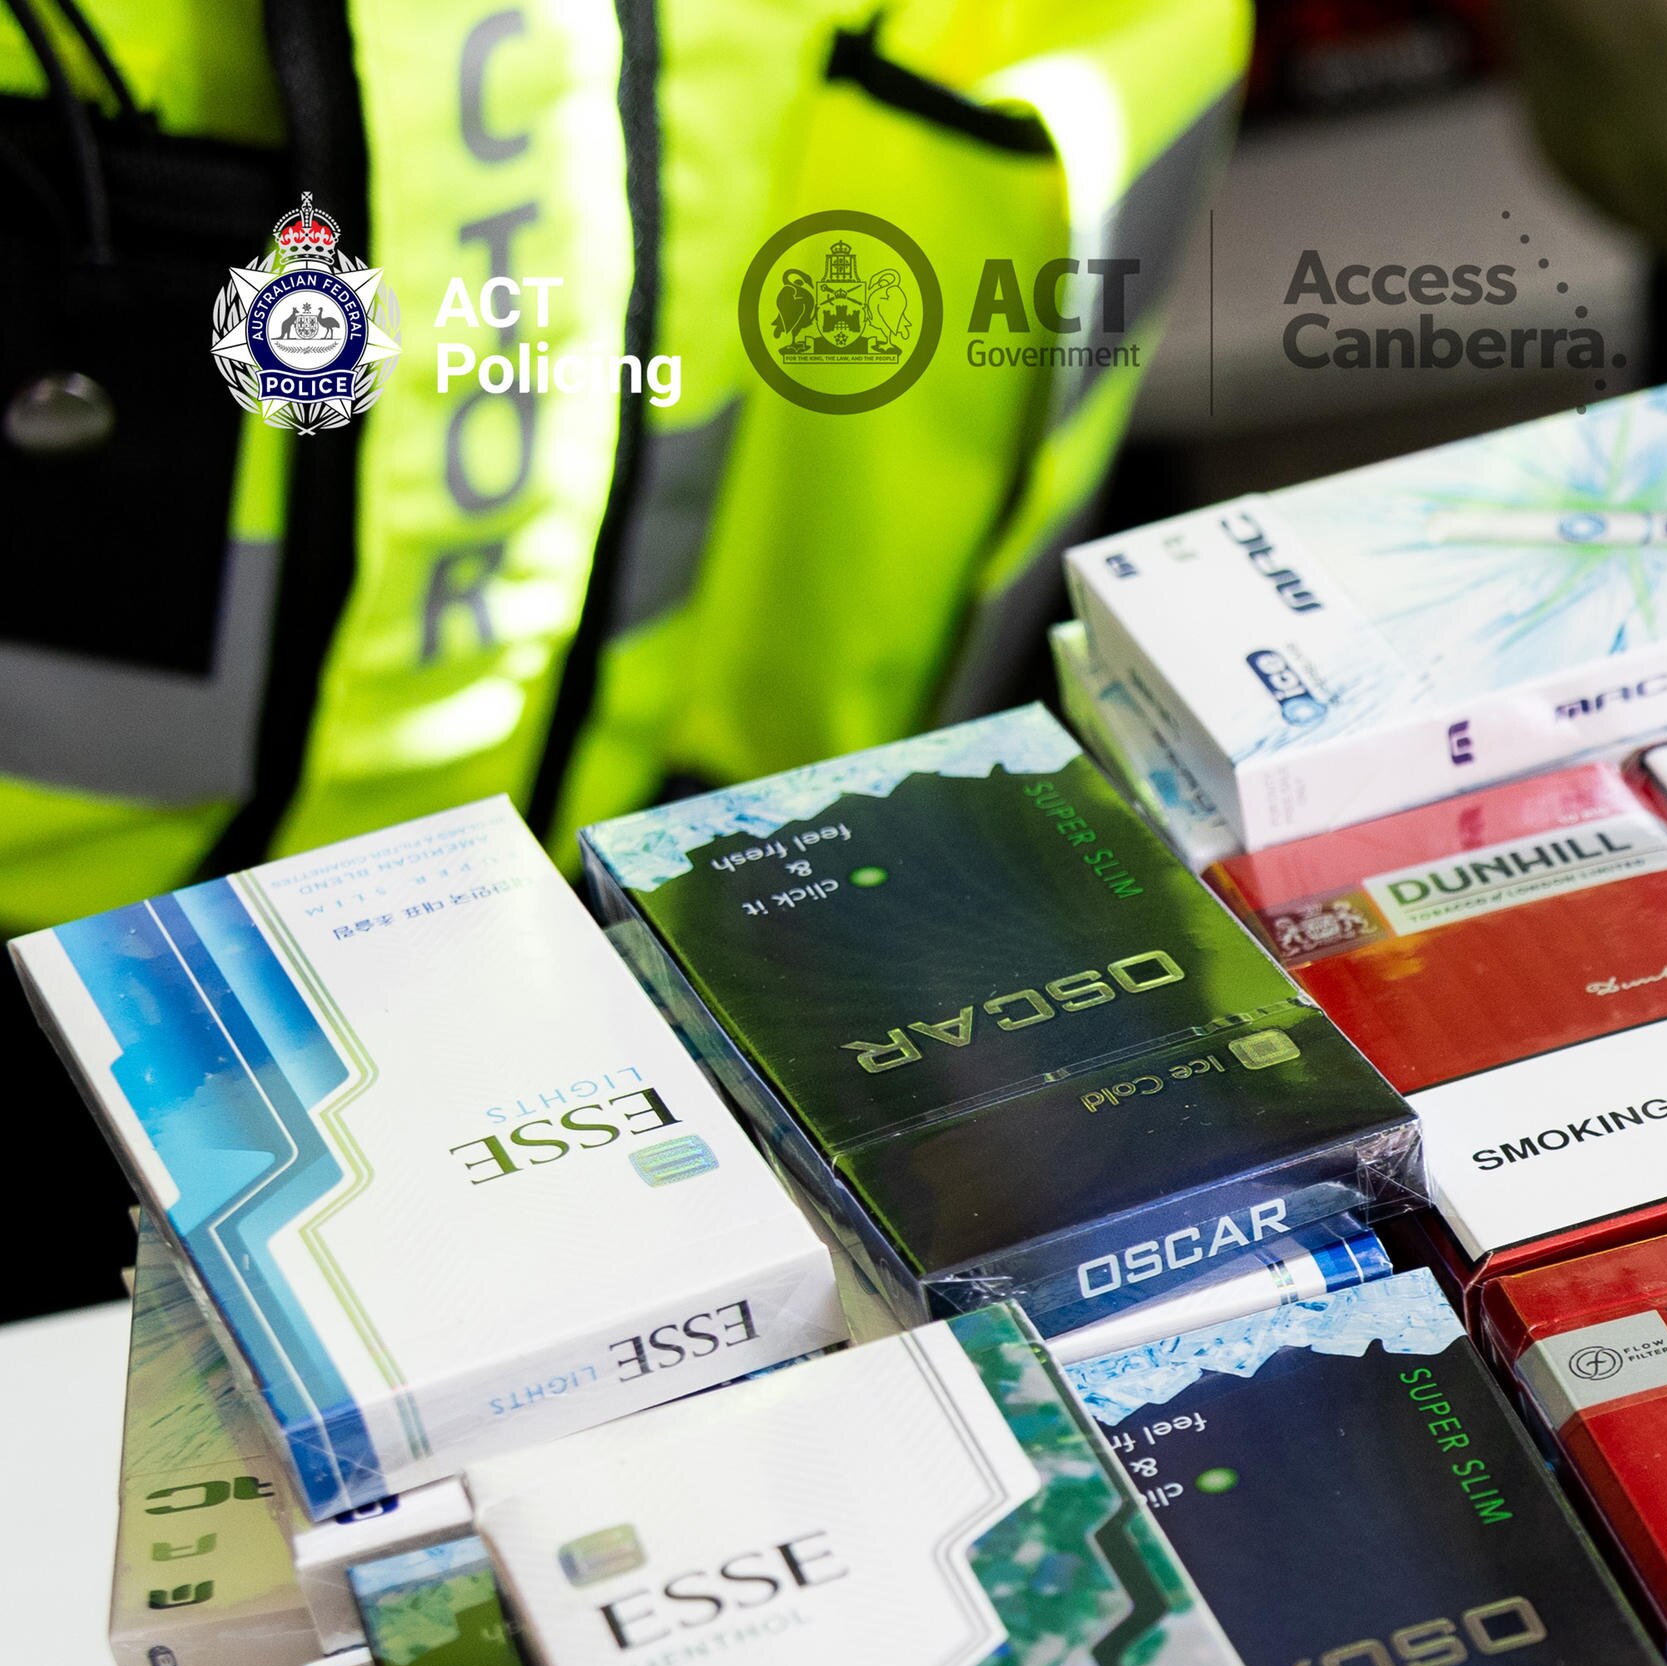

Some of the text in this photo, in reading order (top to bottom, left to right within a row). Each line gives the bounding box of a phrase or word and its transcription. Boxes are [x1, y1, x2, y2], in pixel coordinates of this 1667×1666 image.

[712, 822, 852, 872] feel fresh
[787, 859, 813, 878] &
[1022, 779, 1146, 901] SUPER SLIM
[1387, 831, 1634, 905] DUNHILL
[299, 868, 370, 896] BLEND
[743, 877, 840, 916] click it
[1409, 857, 1647, 923] TOBACCO LONDON LIMITED
[333, 913, 394, 941] 초슬림
[840, 950, 1185, 1075] OSCAR
[486, 1066, 645, 1127] LIGHTS
[1082, 1053, 1225, 1112] Ice Cold
[448, 1087, 685, 1187] ESSE
[1077, 1198, 1291, 1301] OSCAR
[490, 1299, 761, 1417] ESSE LIGHTS
[1623, 1339, 1665, 1355] FLOW
[1150, 1411, 1210, 1440] feel
[1399, 1367, 1515, 1526] SUPER SLIM
[1130, 1455, 1160, 1477] &
[597, 1530, 852, 1654] ESSE
